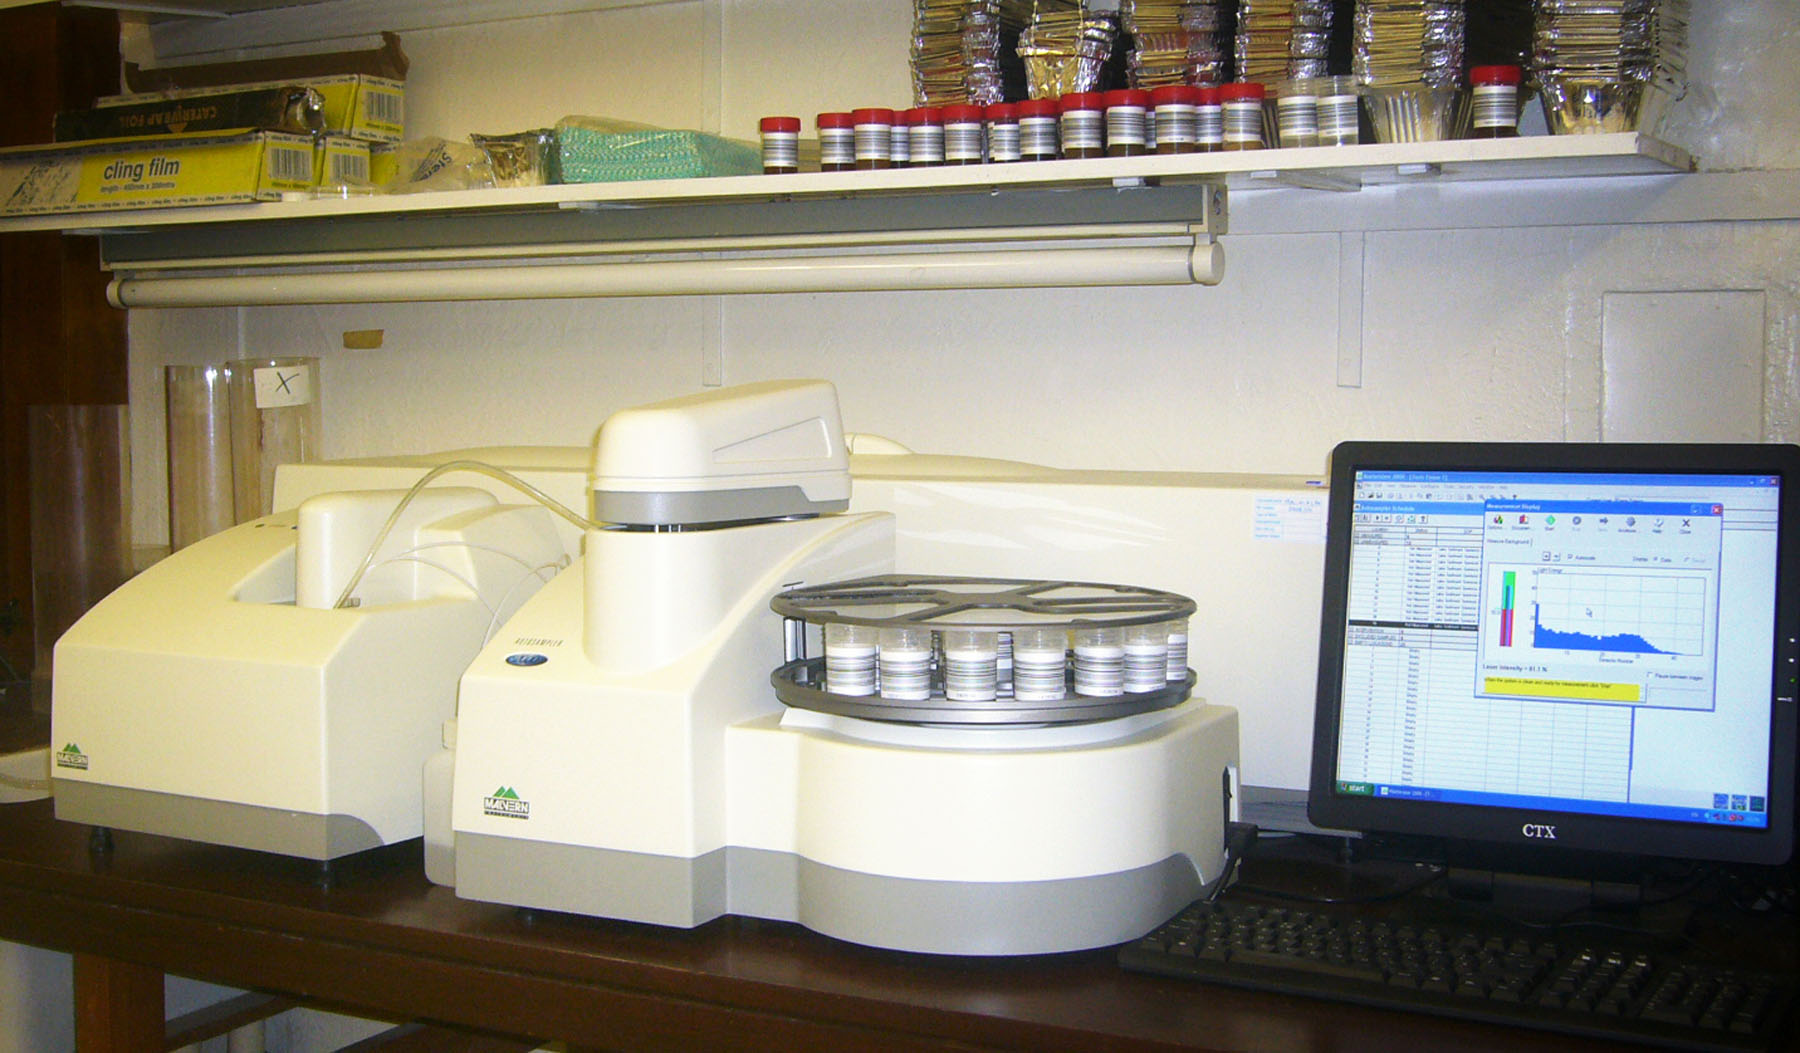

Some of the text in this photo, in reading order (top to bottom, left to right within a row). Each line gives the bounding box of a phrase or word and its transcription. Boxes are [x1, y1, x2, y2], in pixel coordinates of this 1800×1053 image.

[103, 157, 180, 182] cling film
[275, 371, 300, 395] X
[484, 797, 529, 814] MALVERN
[1522, 823, 1556, 839] CTX
